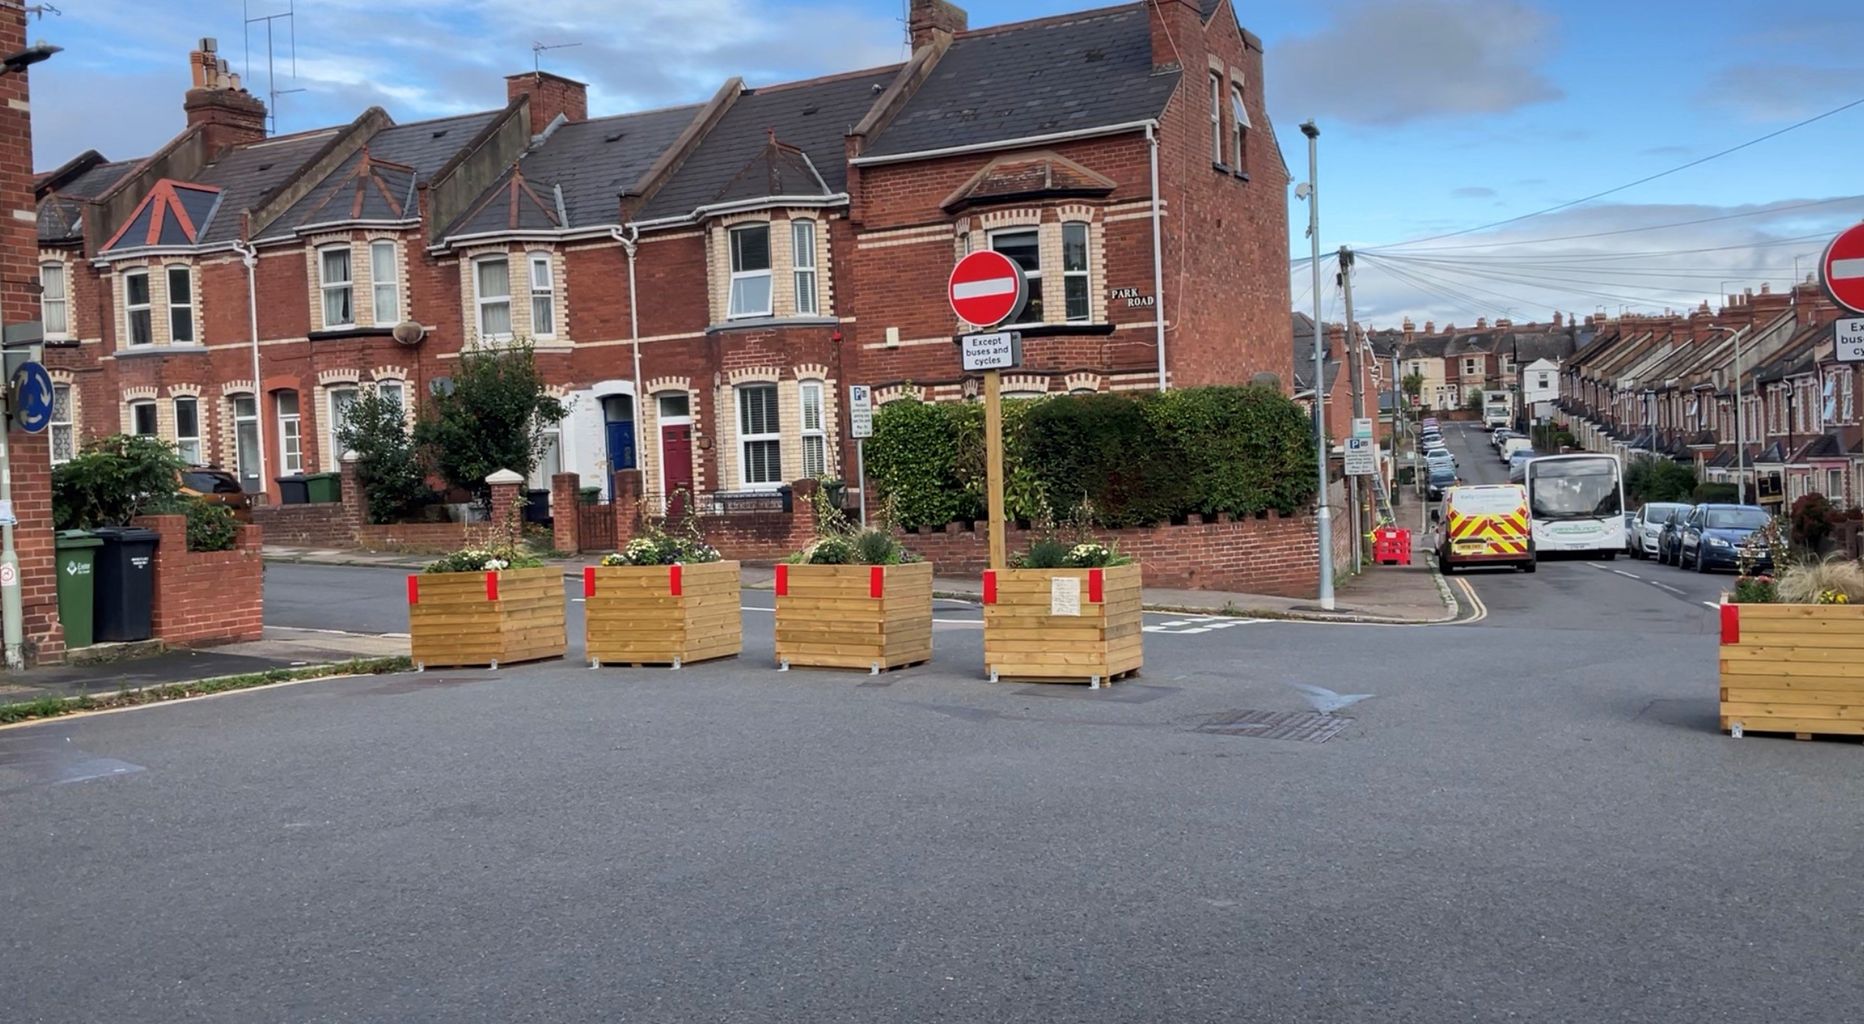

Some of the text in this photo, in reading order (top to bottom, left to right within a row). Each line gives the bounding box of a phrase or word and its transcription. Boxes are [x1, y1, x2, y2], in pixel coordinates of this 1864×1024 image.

[1111, 288, 1138, 299] PARK
[1128, 296, 1154, 307] ROAD
[972, 337, 1002, 347] Except
[1841, 335, 1864, 344] bus
[966, 346, 1009, 357] buses and
[974, 356, 1001, 366] cycles
